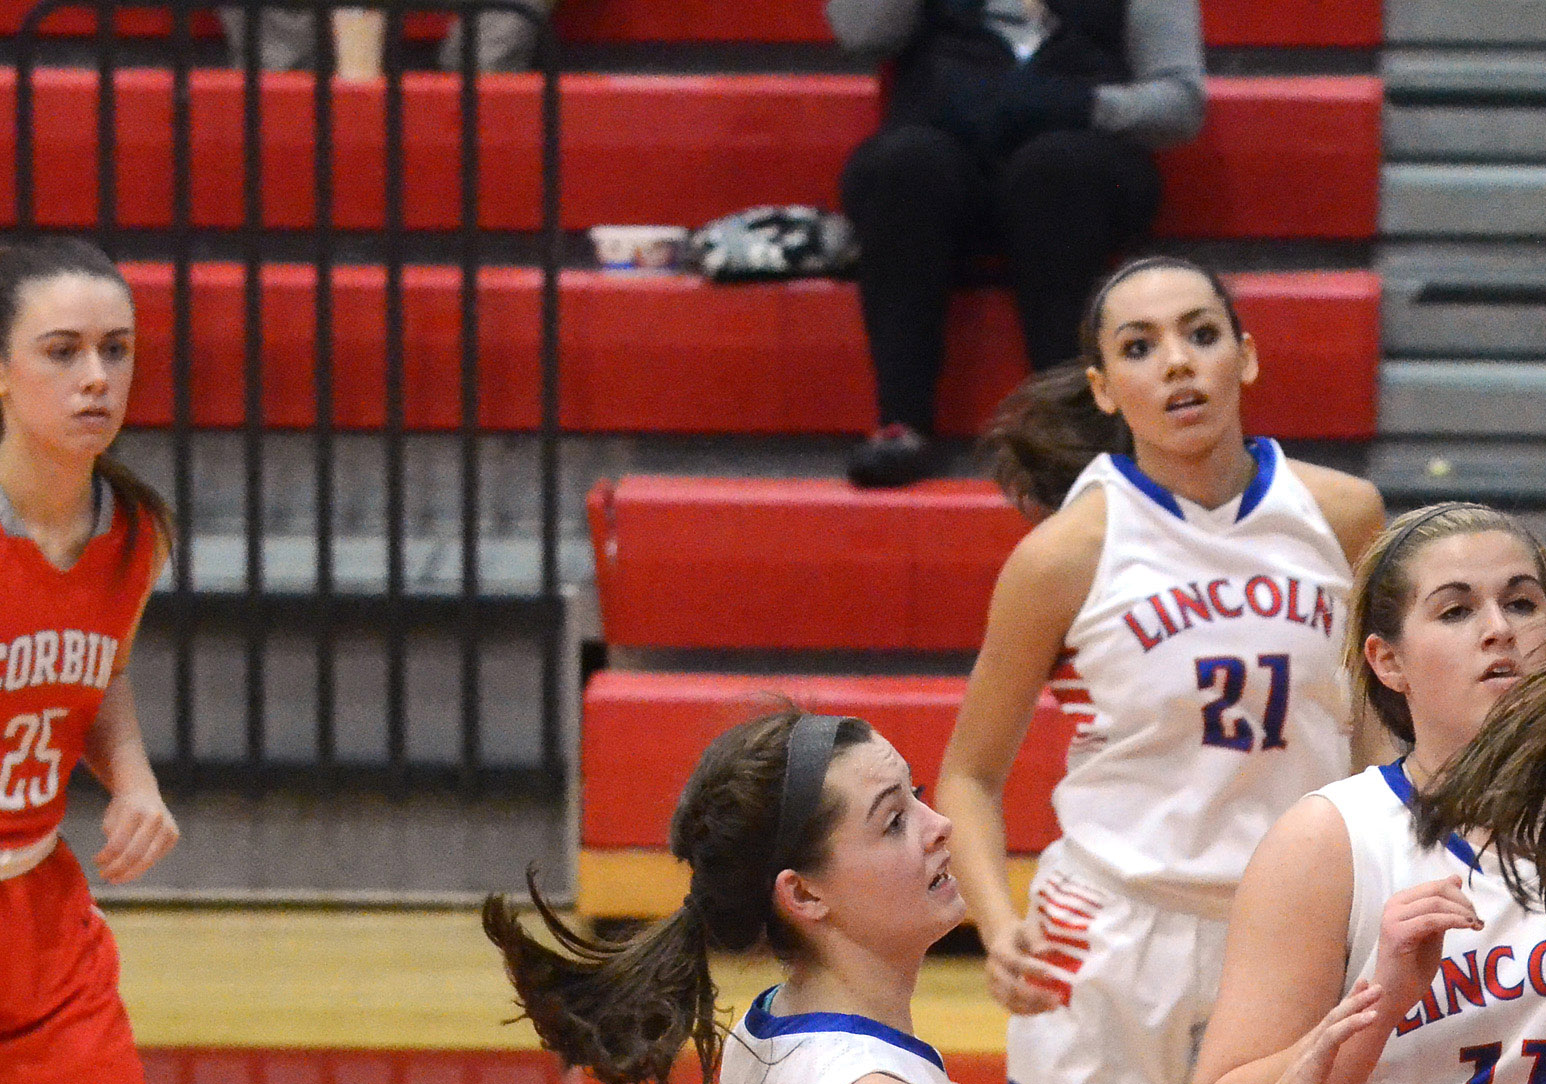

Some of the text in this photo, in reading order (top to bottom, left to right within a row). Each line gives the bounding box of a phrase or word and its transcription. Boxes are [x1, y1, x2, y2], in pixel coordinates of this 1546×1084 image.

[1123, 574, 1334, 654] LINCOLN
[1194, 653, 1290, 753] 21
[0, 707, 70, 811] 25
